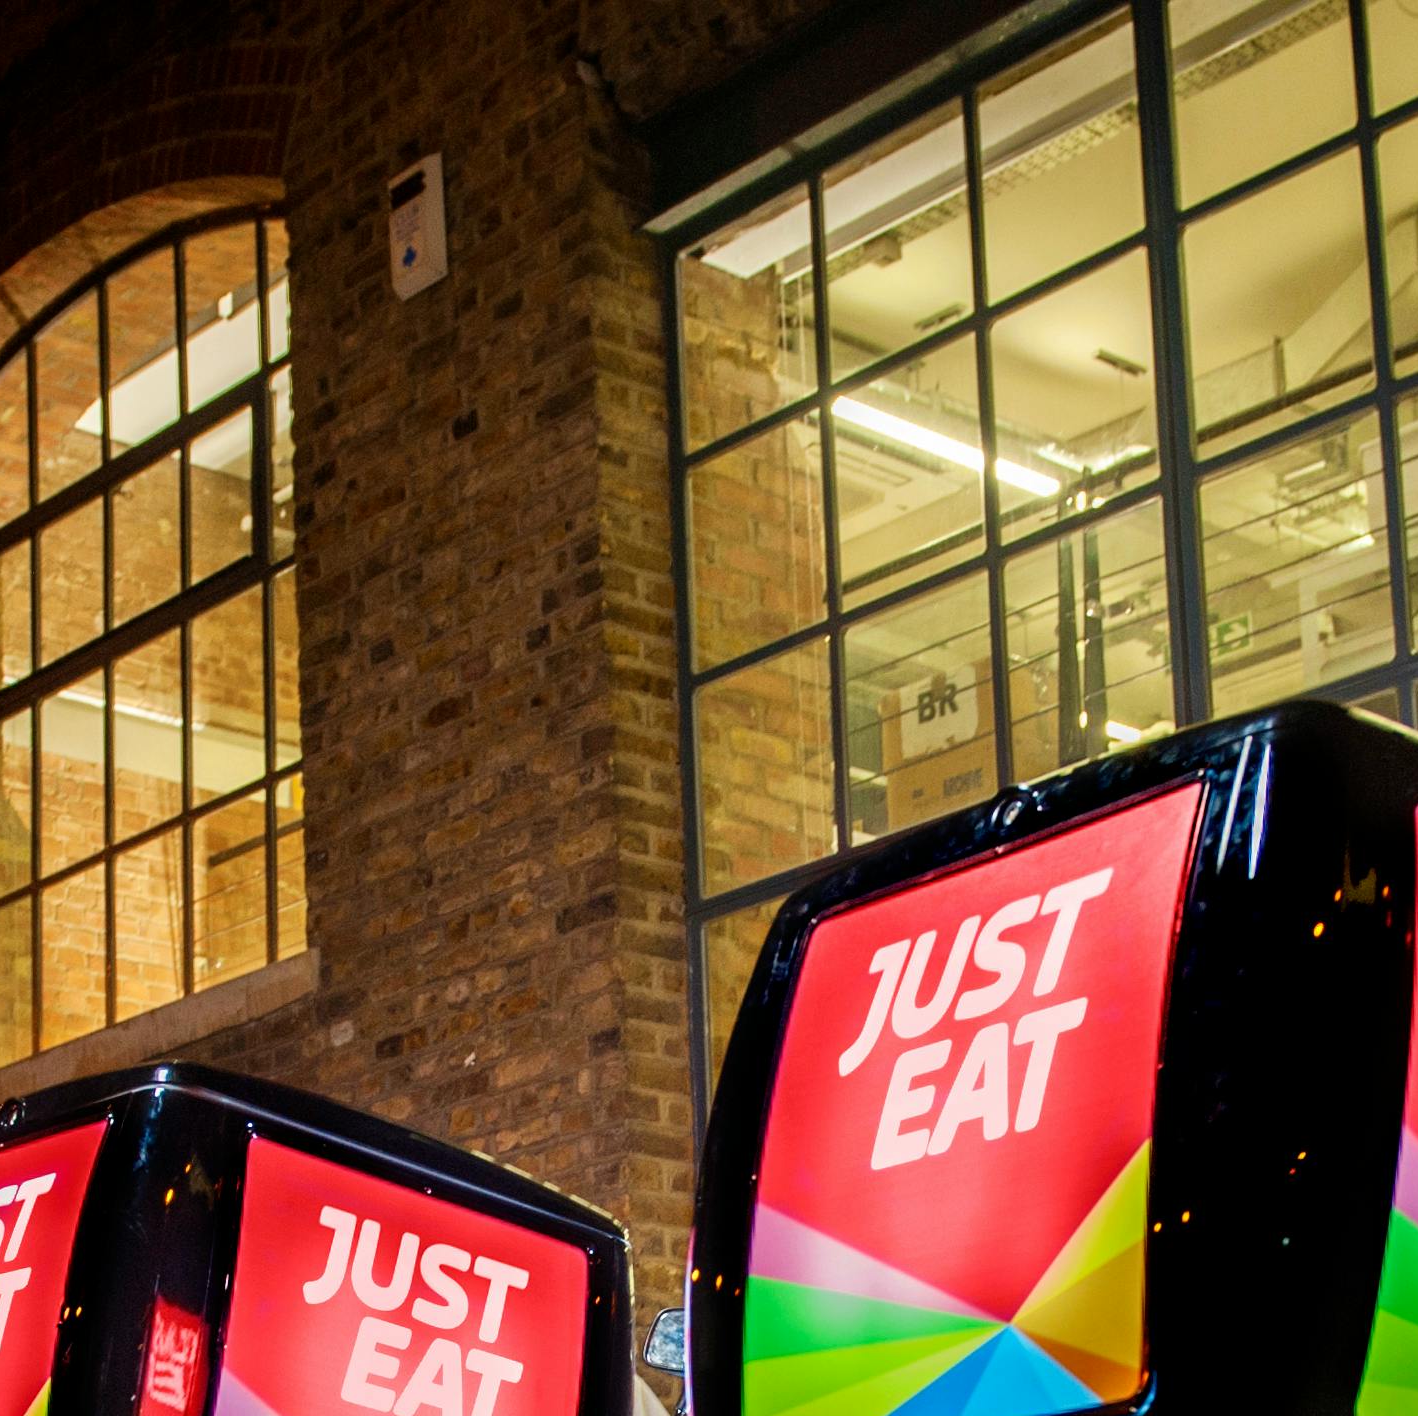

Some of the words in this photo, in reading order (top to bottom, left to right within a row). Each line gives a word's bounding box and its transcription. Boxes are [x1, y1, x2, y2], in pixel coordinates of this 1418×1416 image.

[838, 865, 1116, 1077] JUST
[869, 996, 1089, 1172] EAT
[302, 1205, 530, 1344] JUST
